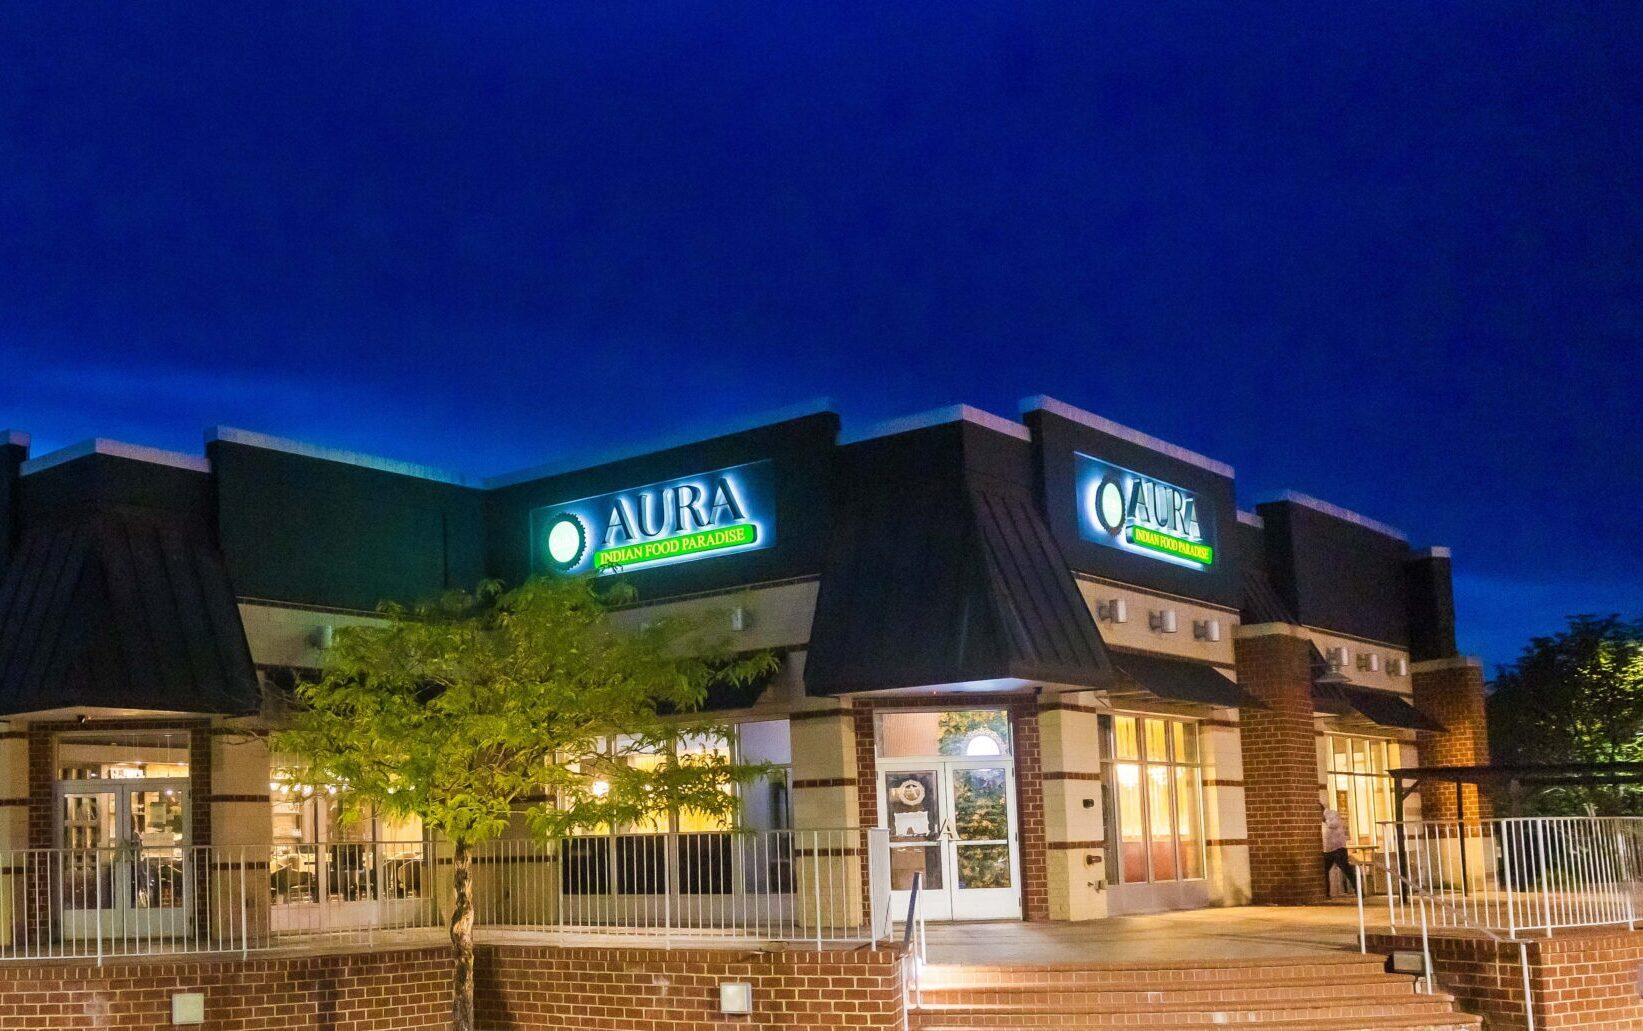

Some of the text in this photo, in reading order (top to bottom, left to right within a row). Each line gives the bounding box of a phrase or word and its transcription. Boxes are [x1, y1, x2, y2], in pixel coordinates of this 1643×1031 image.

[602, 477, 745, 544] AURA
[1126, 478, 1202, 538] AURA
[600, 528, 745, 565] INDIAN FOOD PARADISE
[1135, 528, 1209, 560] INDIAN FOOD PARADISE
